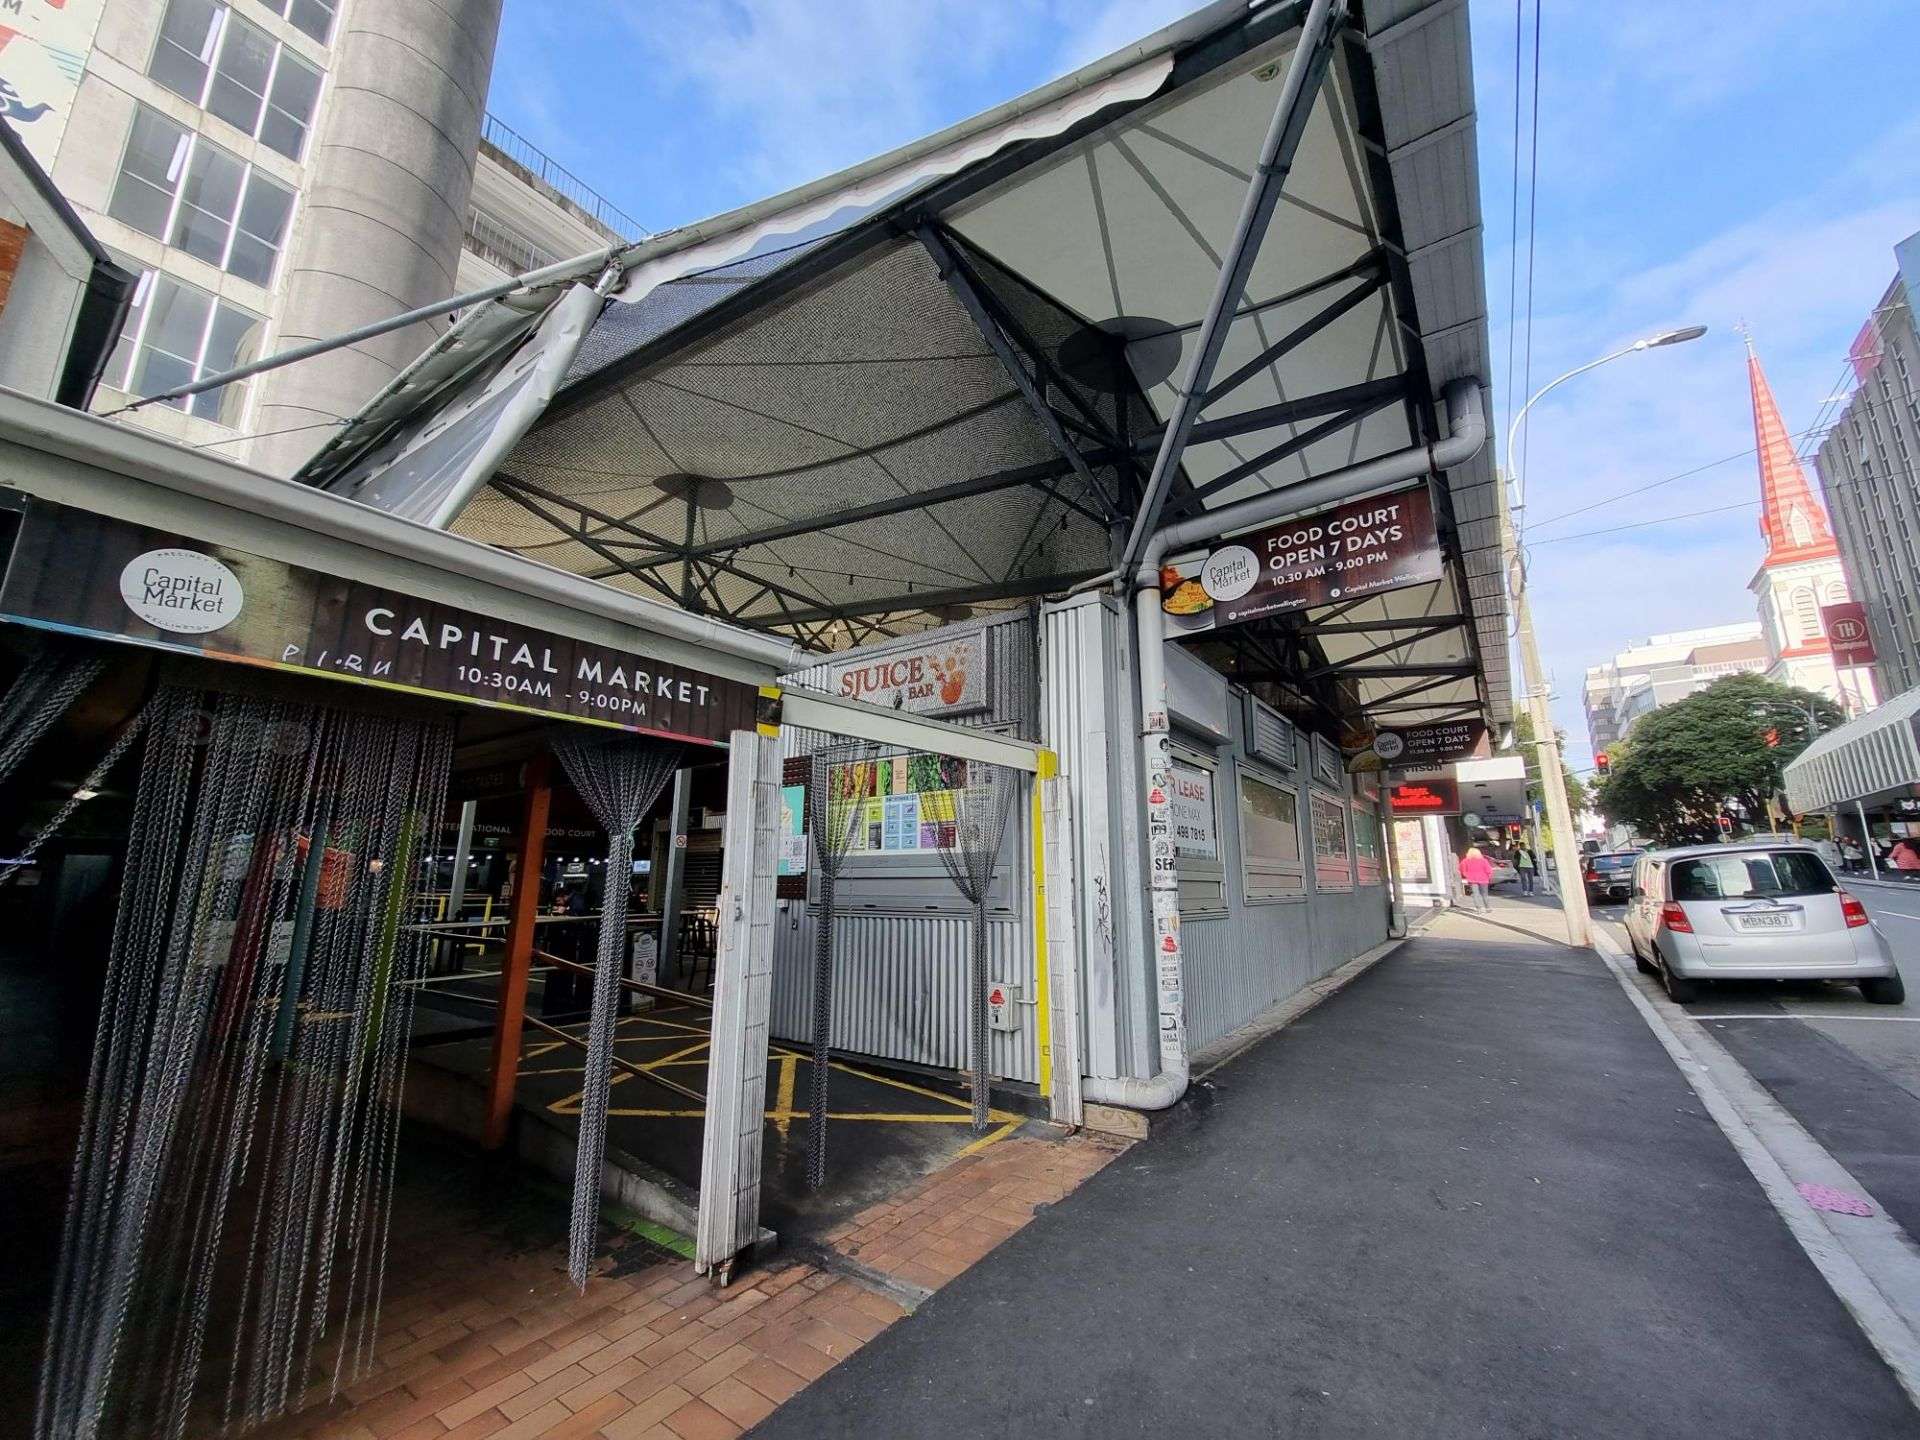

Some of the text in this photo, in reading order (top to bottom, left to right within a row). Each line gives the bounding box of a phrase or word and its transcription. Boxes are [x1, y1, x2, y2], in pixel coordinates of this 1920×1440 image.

[1268, 505, 1400, 552] FOOD COURT
[1269, 544, 1325, 570] OPEN
[1330, 540, 1341, 556] 7
[1347, 525, 1403, 552] DAYS
[1210, 556, 1247, 579] Capital
[1212, 568, 1250, 591] Market
[1272, 571, 1303, 587] 10.30
[1305, 565, 1326, 579] AM
[1336, 557, 1364, 571] 9.00
[1367, 551, 1389, 564] PM
[143, 568, 222, 595] Capital
[142, 587, 224, 613] Market
[1834, 622, 1856, 638] TH
[365, 608, 709, 706] CAPITAL MARKET
[458, 665, 552, 698] 10:30AM
[579, 691, 647, 716] 9:00PM
[908, 684, 934, 699] BAR
[1408, 734, 1471, 747] OPEN 7 DAYS
[1435, 725, 1469, 736] COURT
[1178, 779, 1205, 802] LEASE
